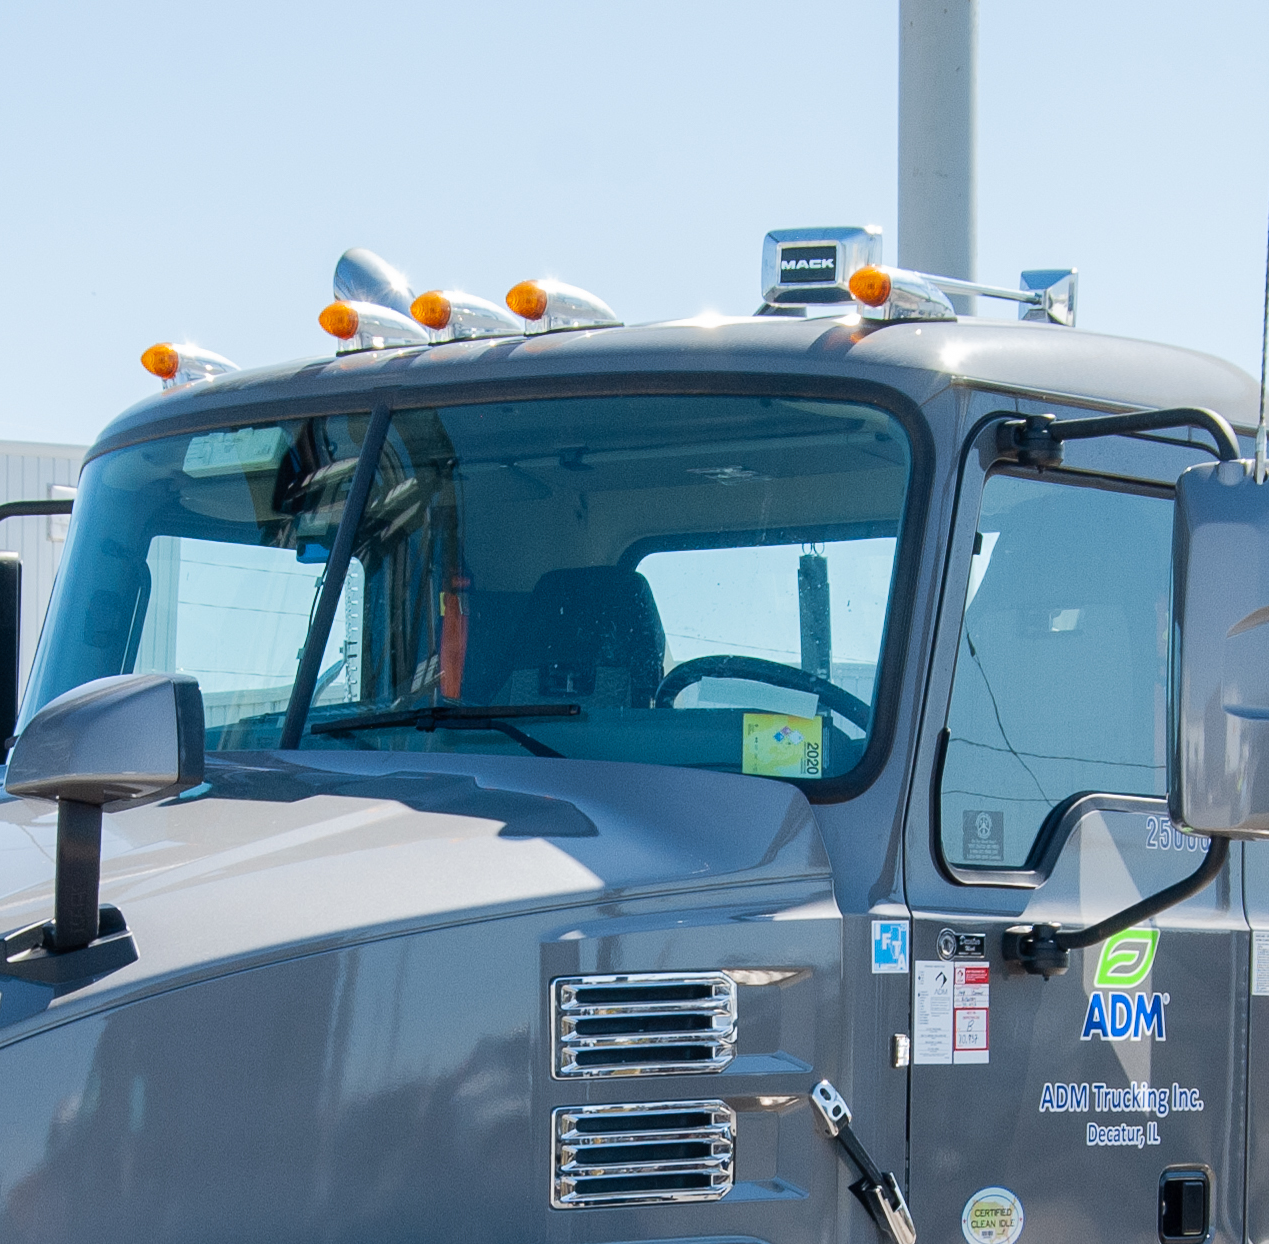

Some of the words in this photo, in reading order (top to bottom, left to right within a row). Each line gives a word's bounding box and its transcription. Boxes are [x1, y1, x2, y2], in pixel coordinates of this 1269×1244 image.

[781, 258, 834, 270] MACK
[807, 742, 819, 775] 2020
[1080, 991, 1167, 1041] ADM
[1039, 1083, 1089, 1112] ADM
[1092, 1081, 1170, 1115] Trucking
[1172, 1082, 1204, 1111] Inc.
[1086, 1122, 1145, 1148] Decatur,
[1147, 1122, 1161, 1144] IL
[971, 1219, 996, 1229] CLEAN
[999, 1219, 1015, 1228] IDLE
[974, 1208, 1012, 1218] CERTIFIED
